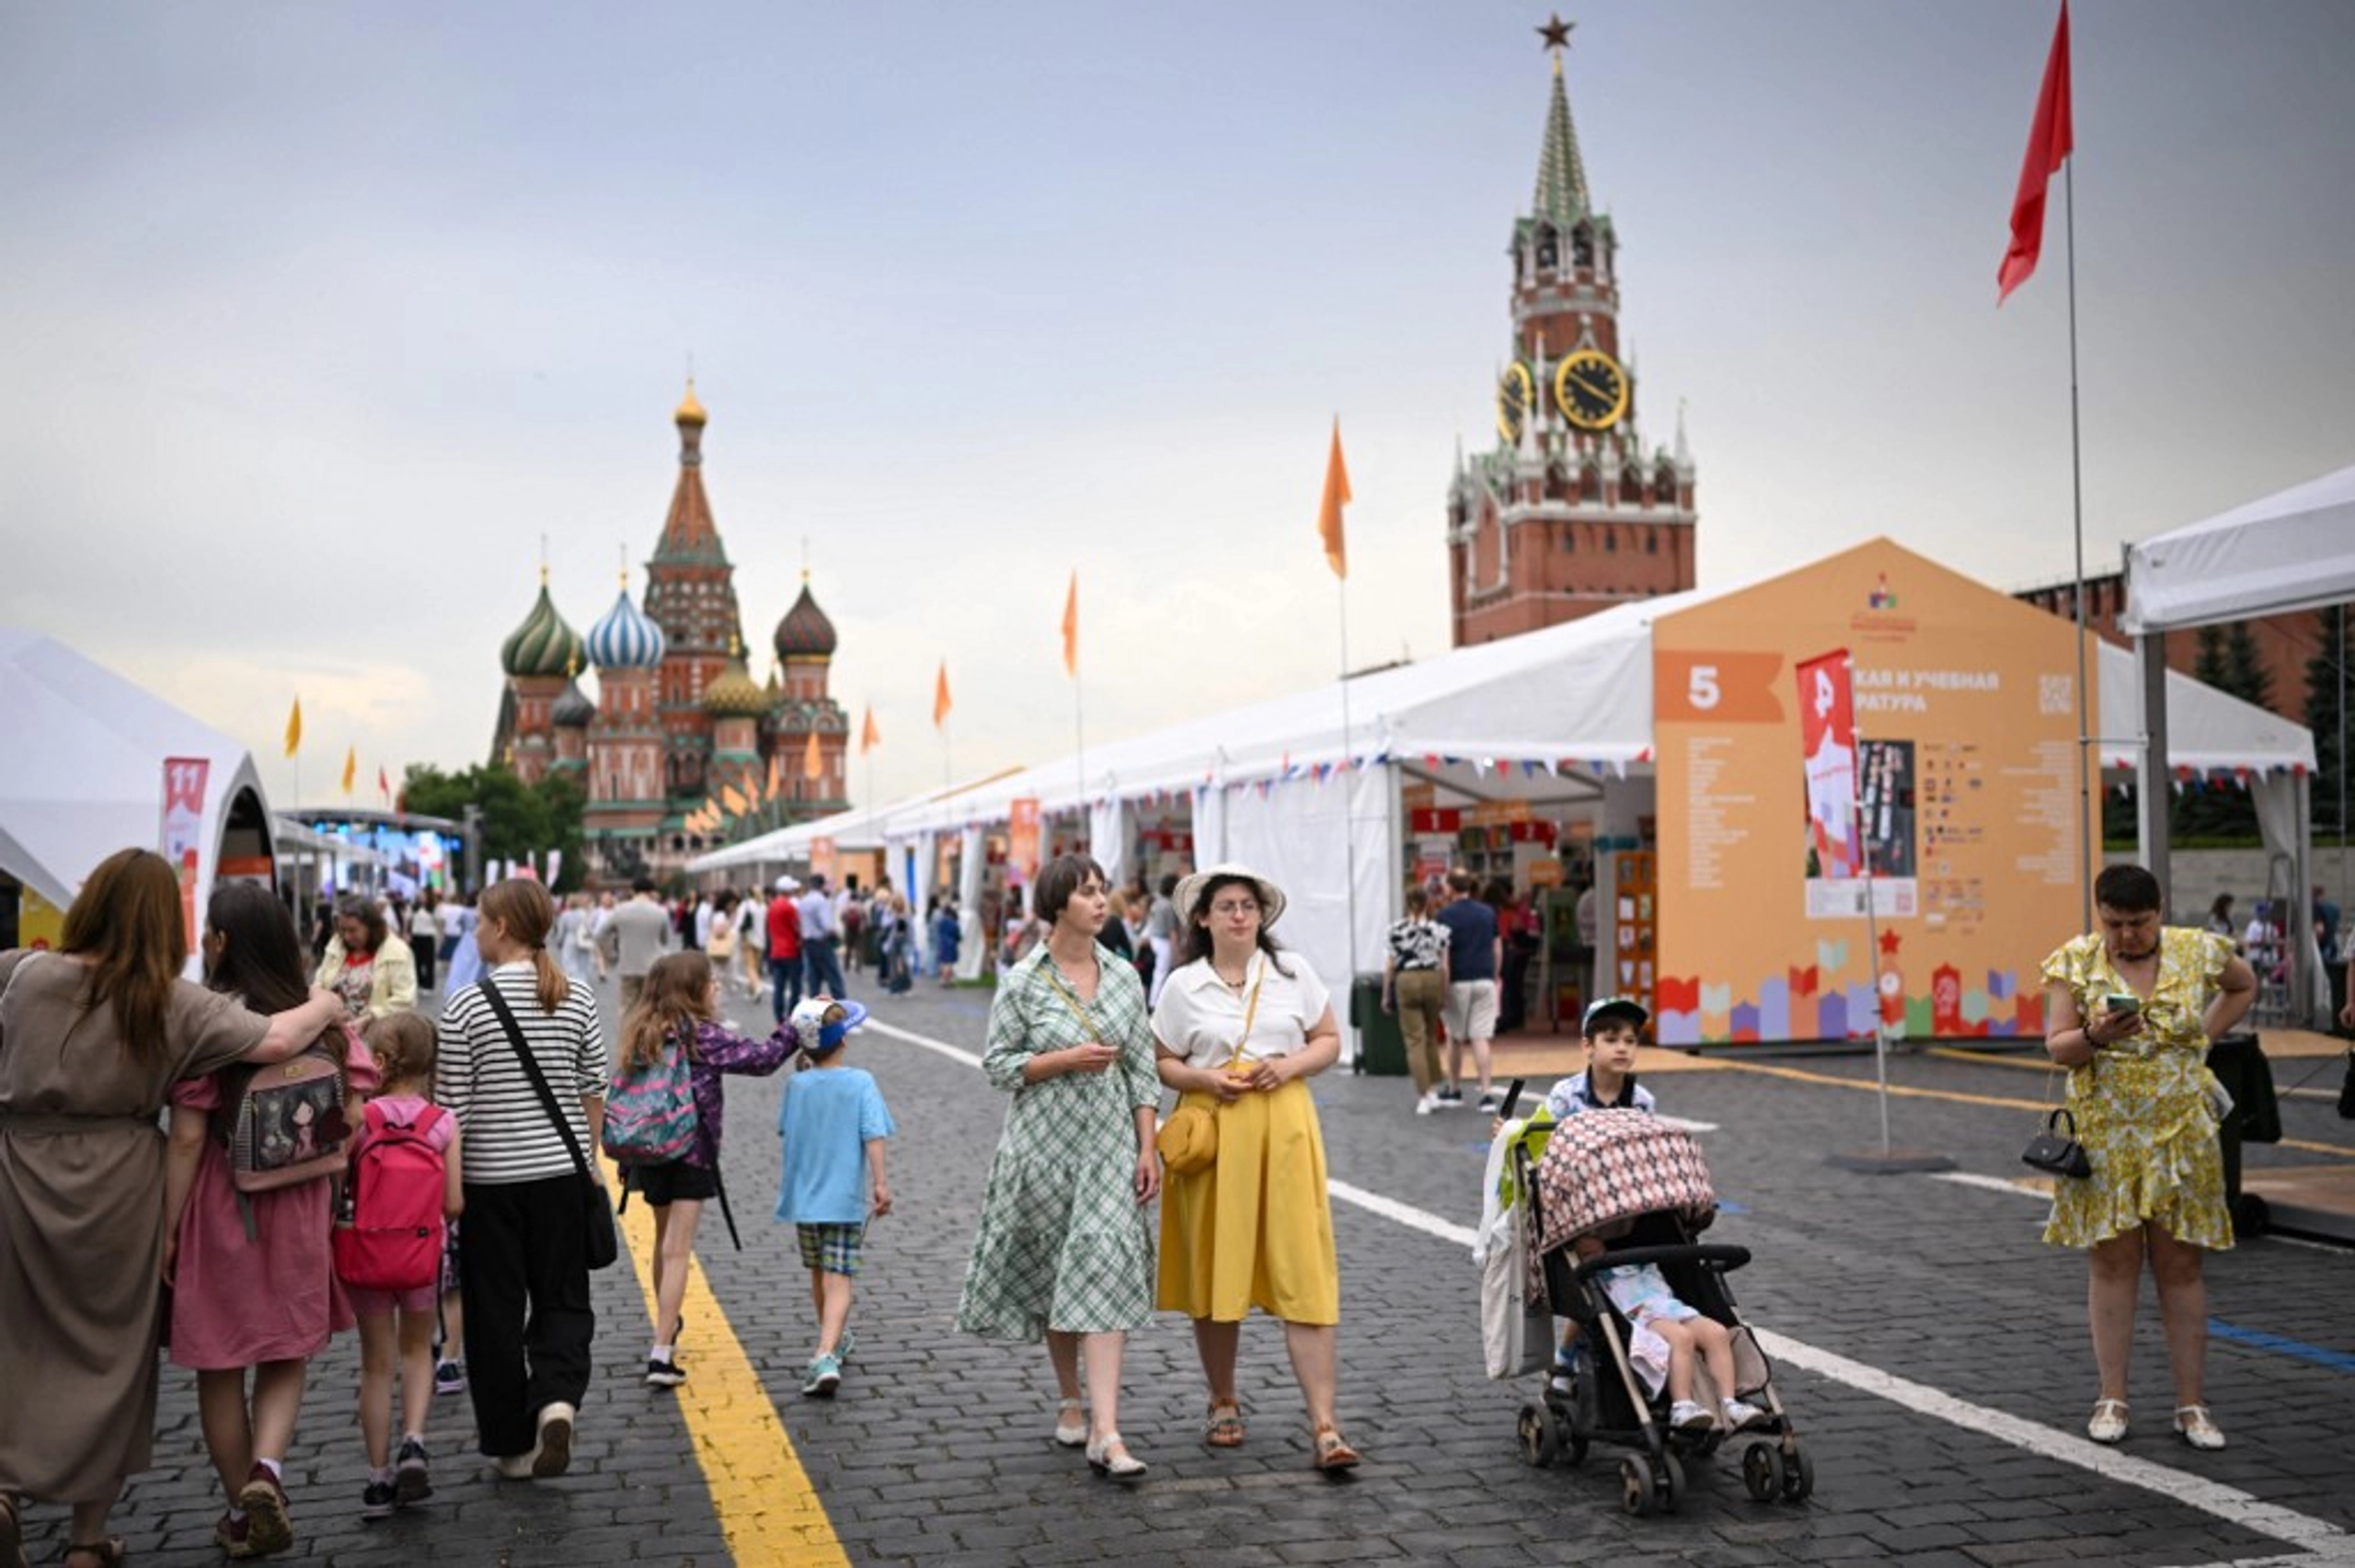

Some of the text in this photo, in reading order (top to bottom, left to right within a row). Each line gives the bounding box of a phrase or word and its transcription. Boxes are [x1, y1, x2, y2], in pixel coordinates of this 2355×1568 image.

[1688, 666, 1720, 710] 5
[1855, 670, 2000, 690] КАЯ И УЧЕБНАЯ
[1855, 693, 1927, 713] РАТУРА
[170, 764, 198, 794] 11
